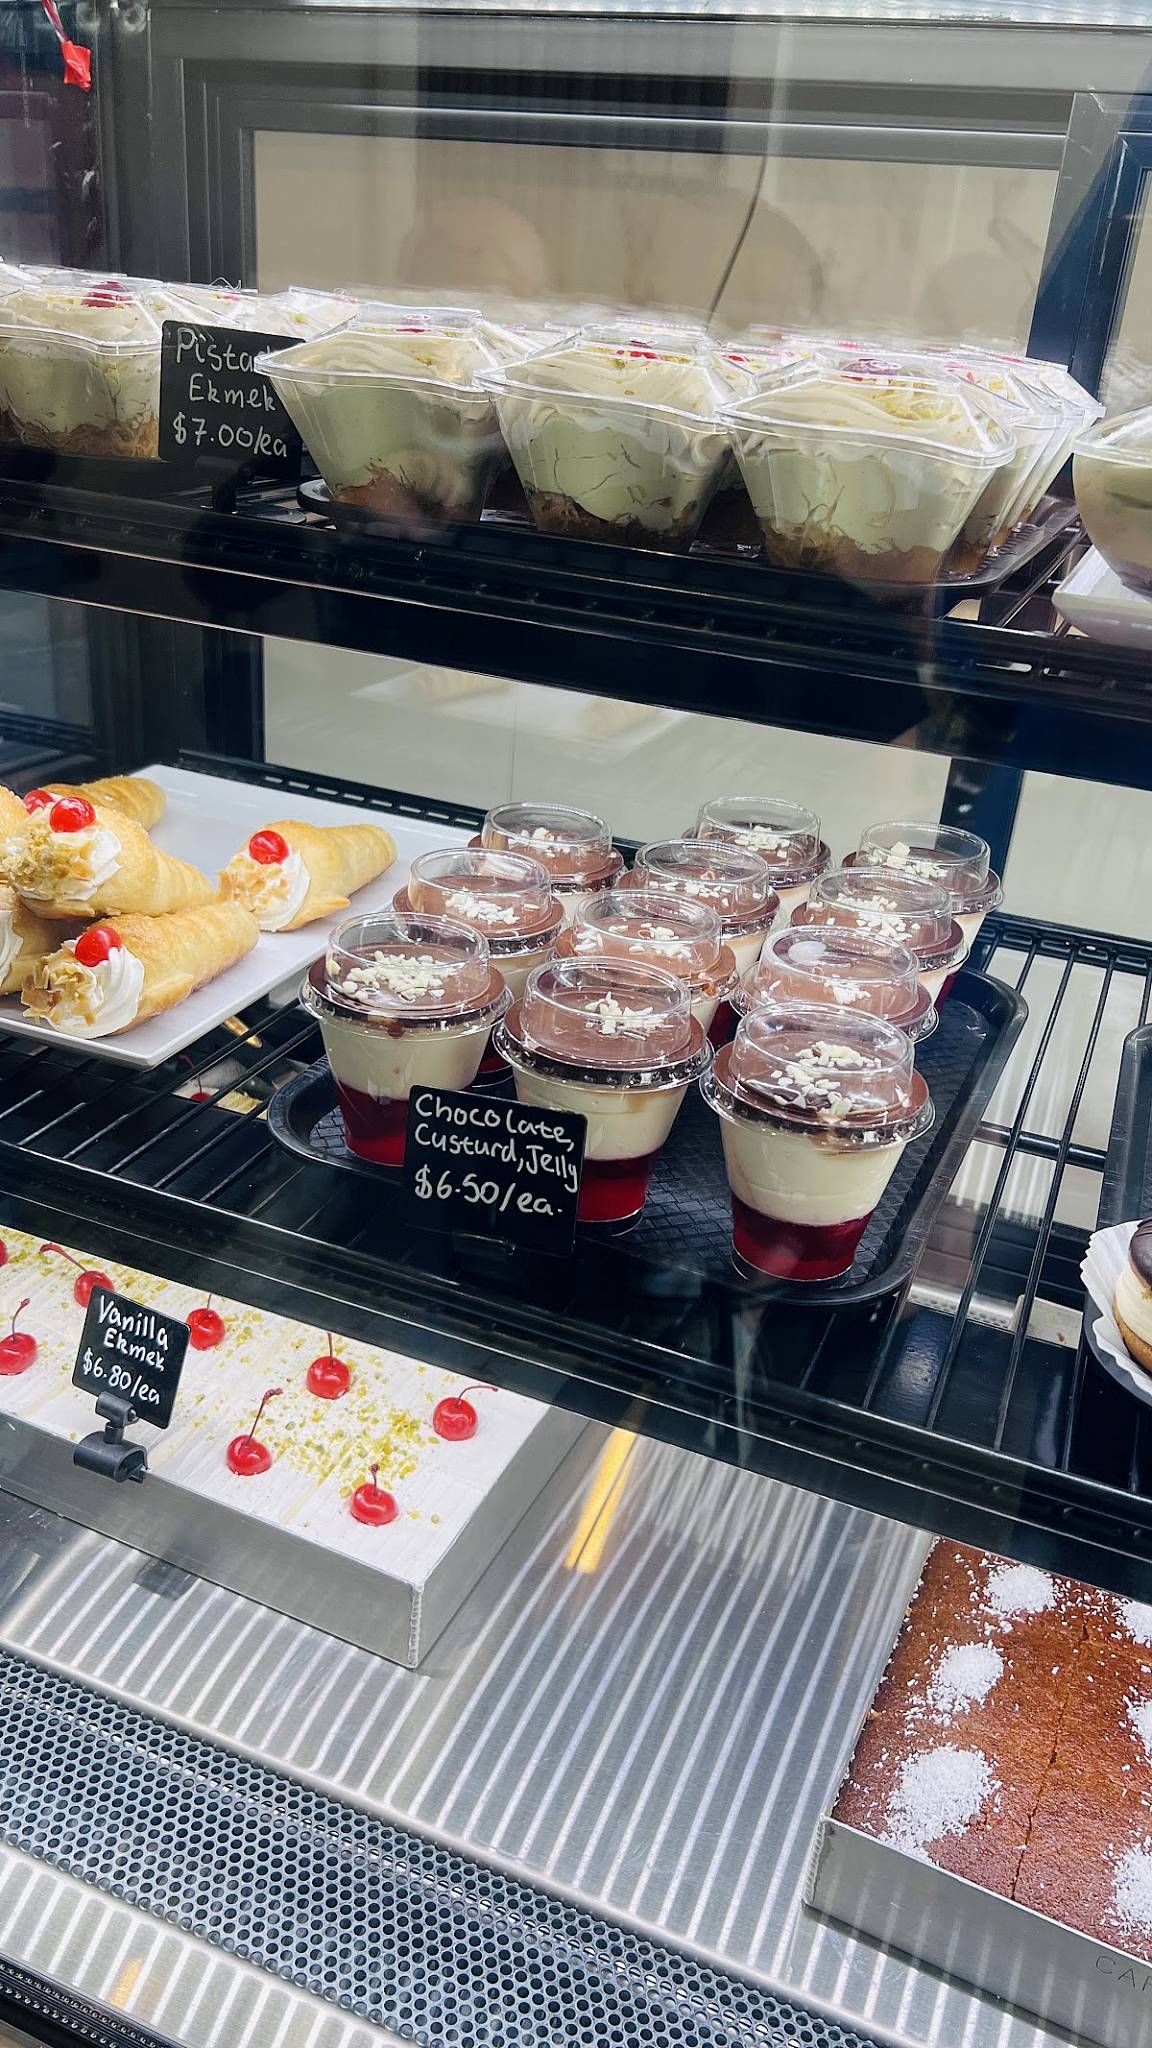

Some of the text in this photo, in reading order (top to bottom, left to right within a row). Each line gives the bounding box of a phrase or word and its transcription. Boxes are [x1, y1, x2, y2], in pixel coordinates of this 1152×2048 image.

[176, 327, 271, 373] Pista
[189, 372, 279, 412] Ekmek
[172, 411, 288, 457] $7.00/ea
[415, 1093, 575, 1152] Chocolate,
[98, 1294, 169, 1351] Vanilla
[103, 1327, 165, 1372] Ekmek
[82, 1347, 160, 1405] $6.80/ea
